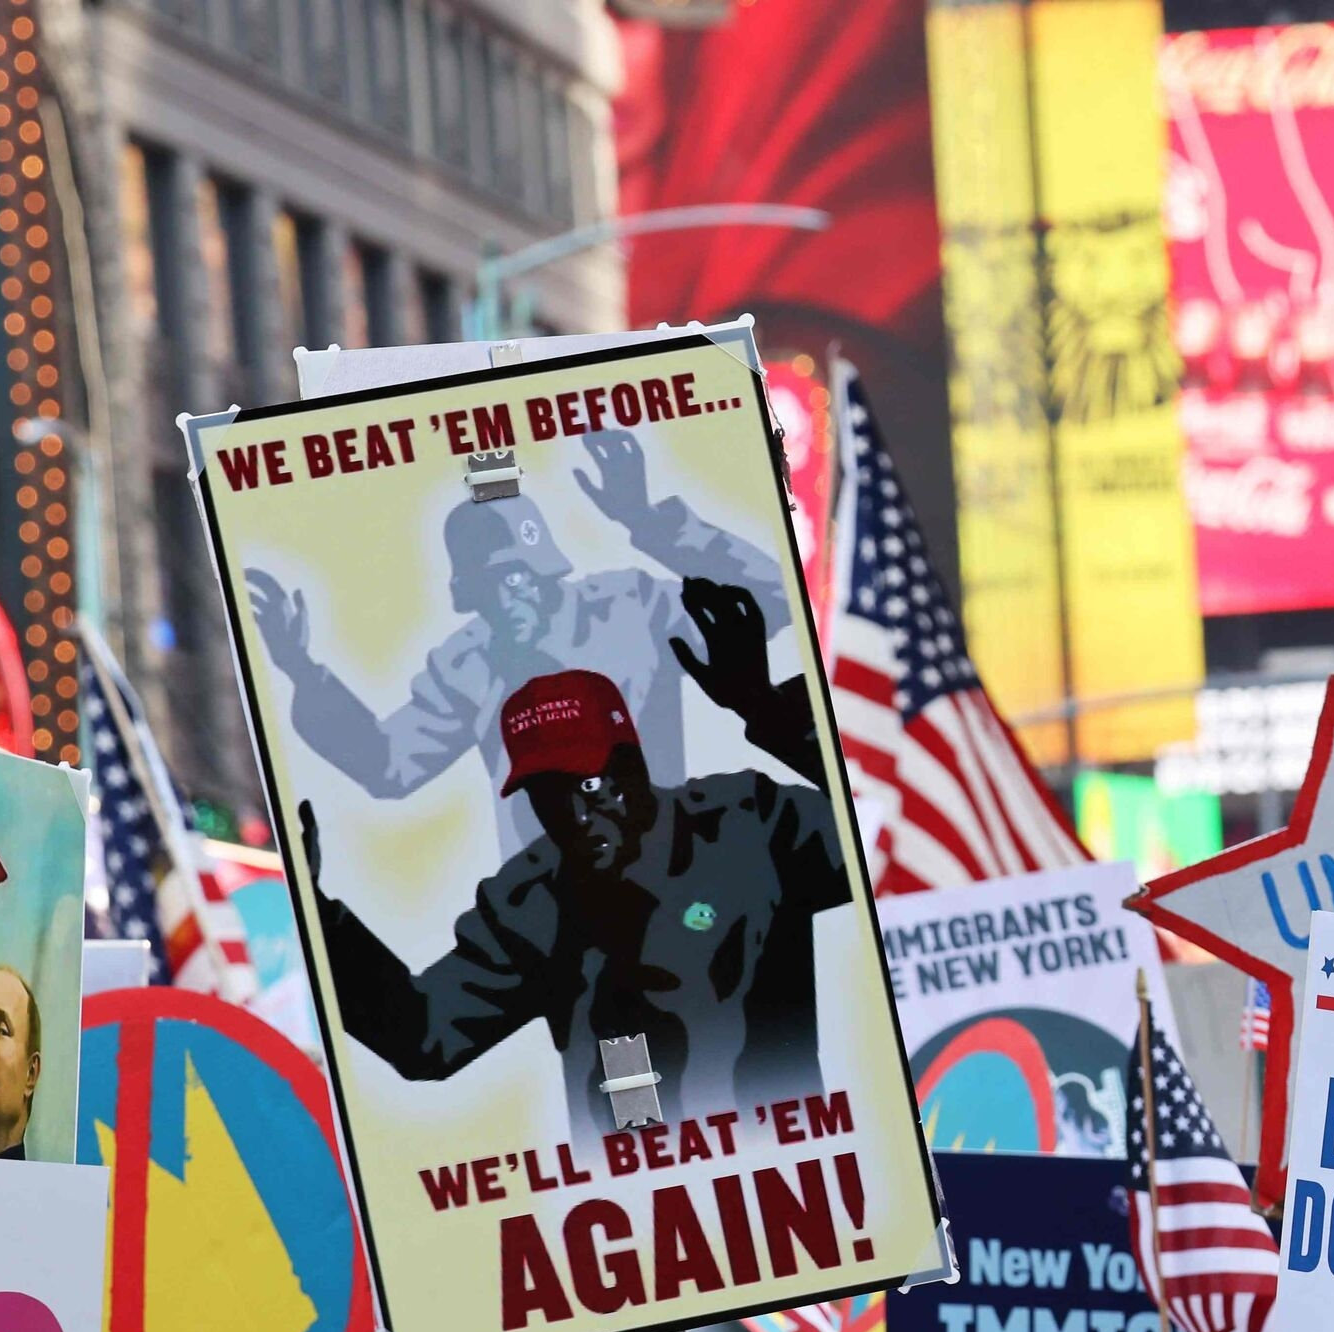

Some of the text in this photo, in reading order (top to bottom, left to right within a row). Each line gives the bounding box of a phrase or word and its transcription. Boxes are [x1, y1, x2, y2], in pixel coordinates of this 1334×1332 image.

[216, 372, 742, 492] WE BEAT 'EM BEFORE...
[917, 952, 1001, 997] NEW
[1013, 927, 1129, 979] YORK!
[419, 1089, 855, 1212] WE'LL BEAT 'EM
[499, 1151, 875, 1332] AGAIN!
[969, 1238, 1071, 1289] New
